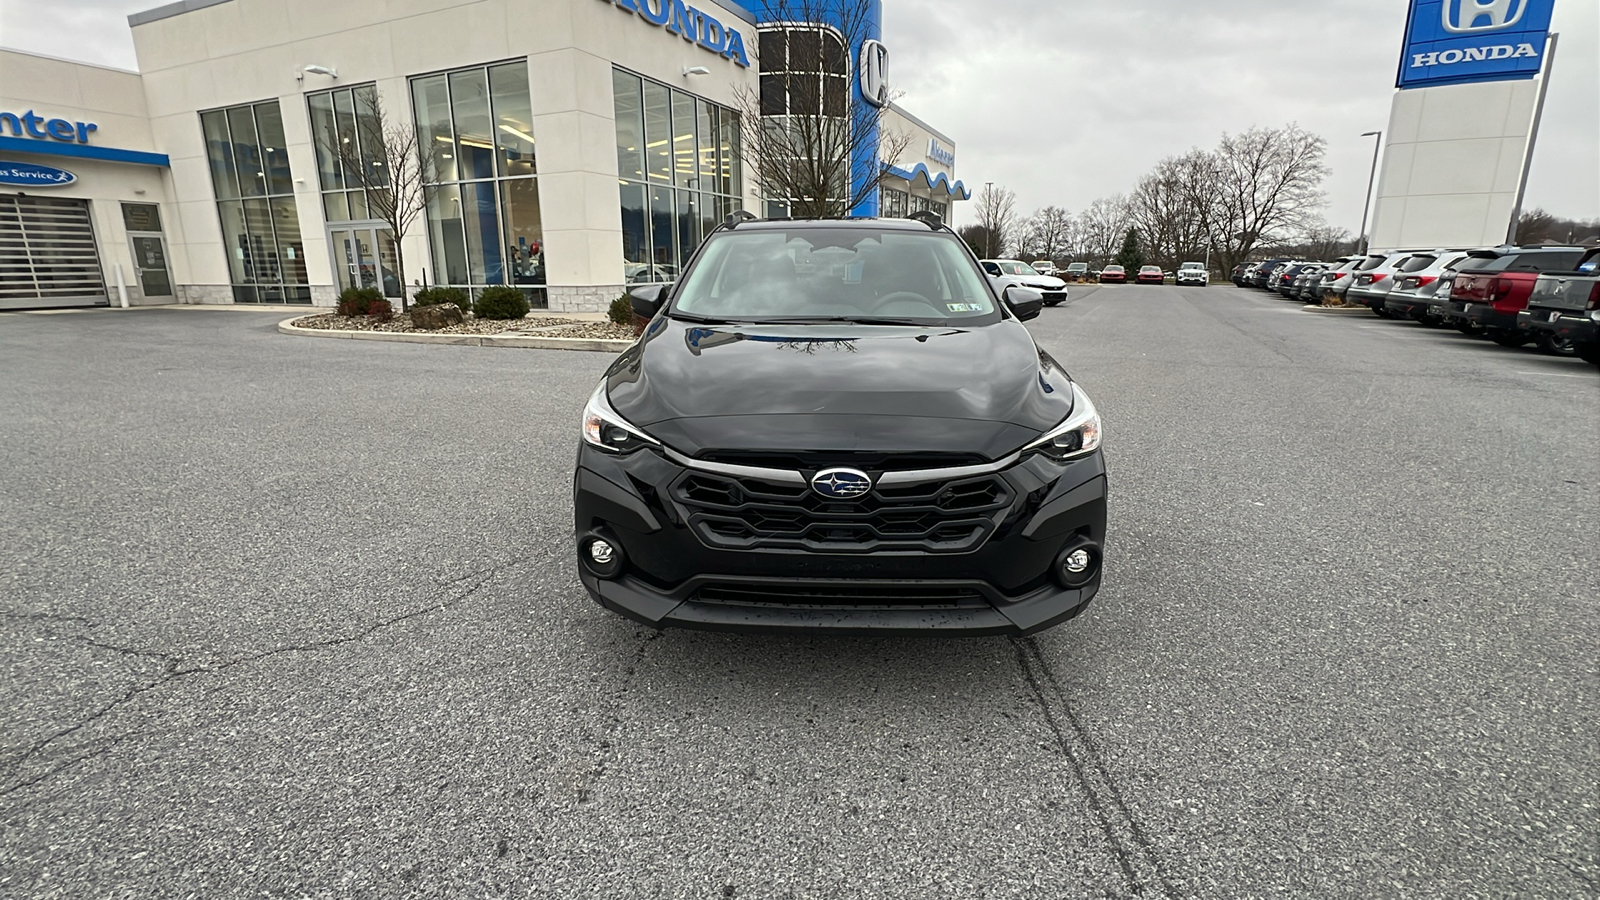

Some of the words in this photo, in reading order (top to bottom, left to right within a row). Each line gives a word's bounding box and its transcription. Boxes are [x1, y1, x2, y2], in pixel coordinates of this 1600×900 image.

[598, 0, 750, 67] ONDA
[1411, 43, 1538, 68] HONDA
[11, 169, 54, 180] Service
